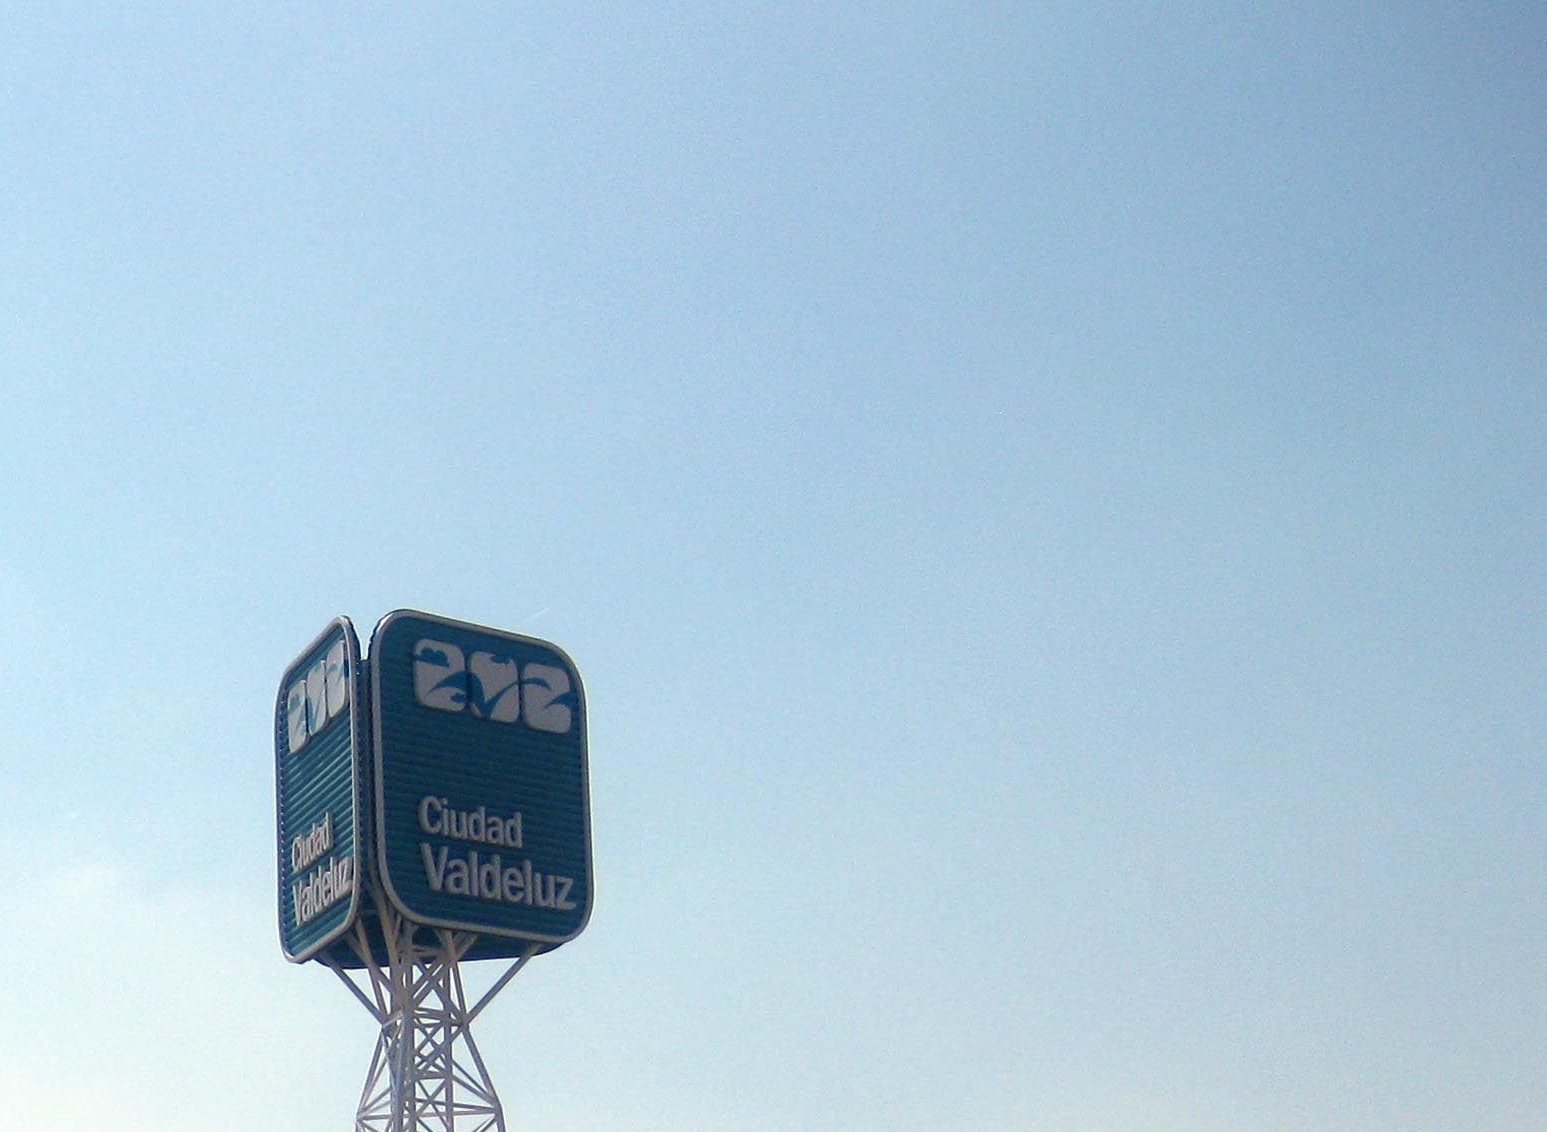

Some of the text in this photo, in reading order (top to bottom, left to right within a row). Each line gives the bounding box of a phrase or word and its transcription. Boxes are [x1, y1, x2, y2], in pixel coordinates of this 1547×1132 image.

[292, 812, 333, 873] Ciudad
[419, 795, 523, 848] Ciudad
[293, 857, 353, 927] Valdeluz
[419, 842, 576, 910] Valdeluz
